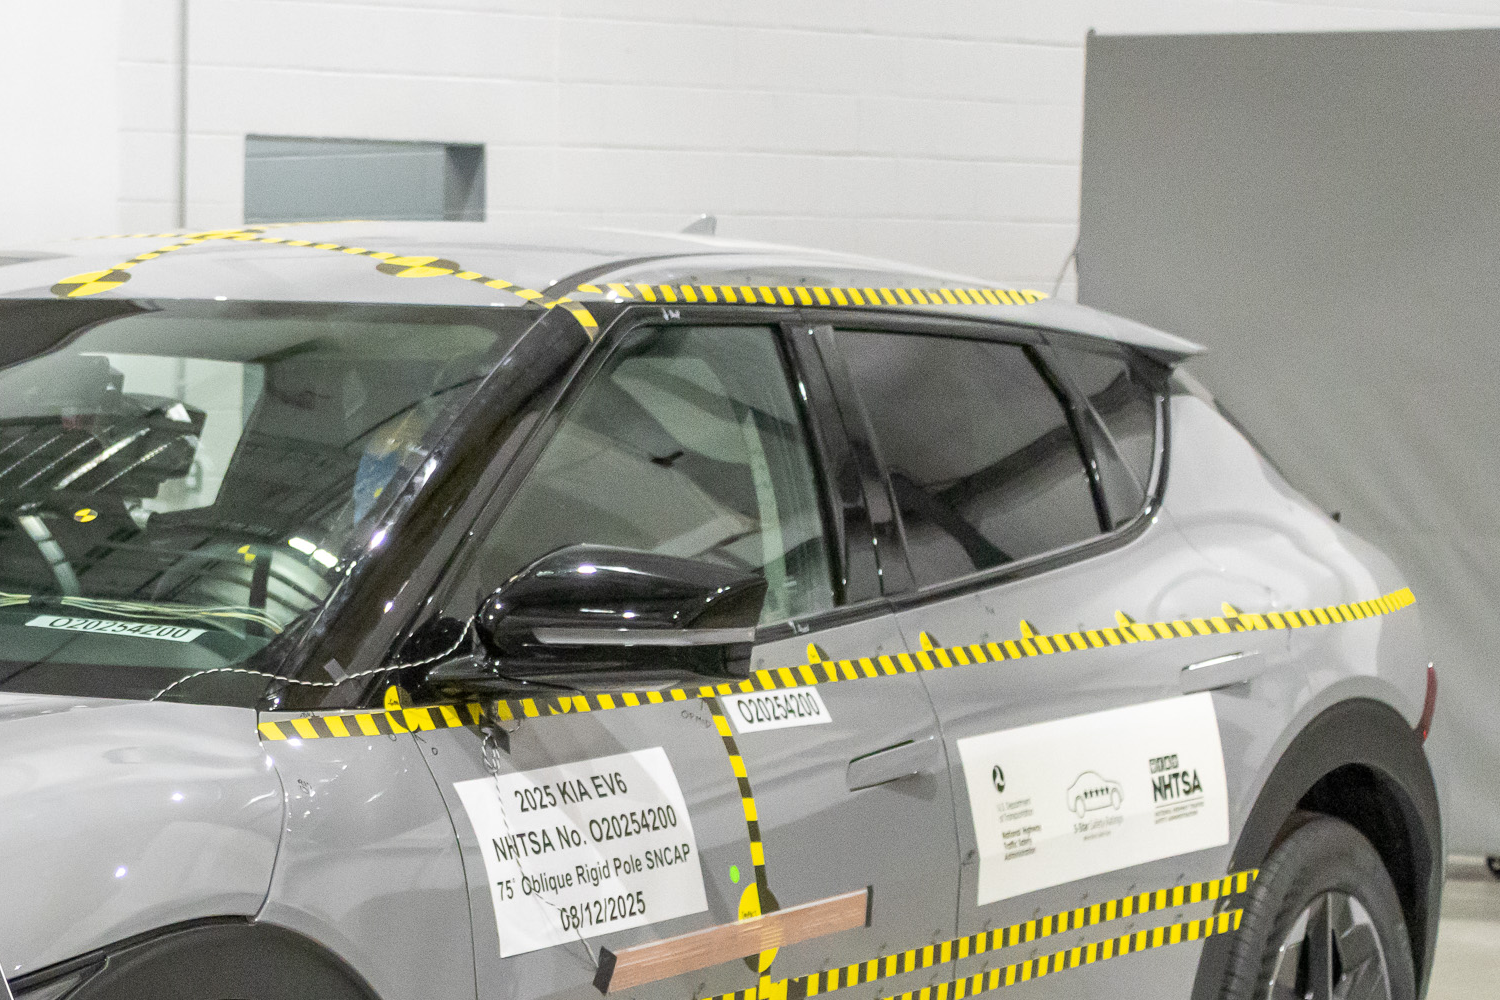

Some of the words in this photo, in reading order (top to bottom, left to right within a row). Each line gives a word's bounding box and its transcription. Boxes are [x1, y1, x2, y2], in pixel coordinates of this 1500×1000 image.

[737, 692, 821, 724] O20254200
[514, 785, 557, 812] 2025
[556, 779, 593, 805] KIA
[590, 772, 628, 799] EV6
[1151, 769, 1203, 802] NHTSA
[492, 828, 555, 862] NHTSA
[555, 825, 587, 850] No.
[588, 804, 677, 842] O20254200
[521, 871, 573, 896] Oblique
[575, 860, 611, 888] Rigid
[614, 854, 642, 876] Pole
[640, 843, 691, 870] SNCAP
[560, 891, 646, 931] 08/12/2025
